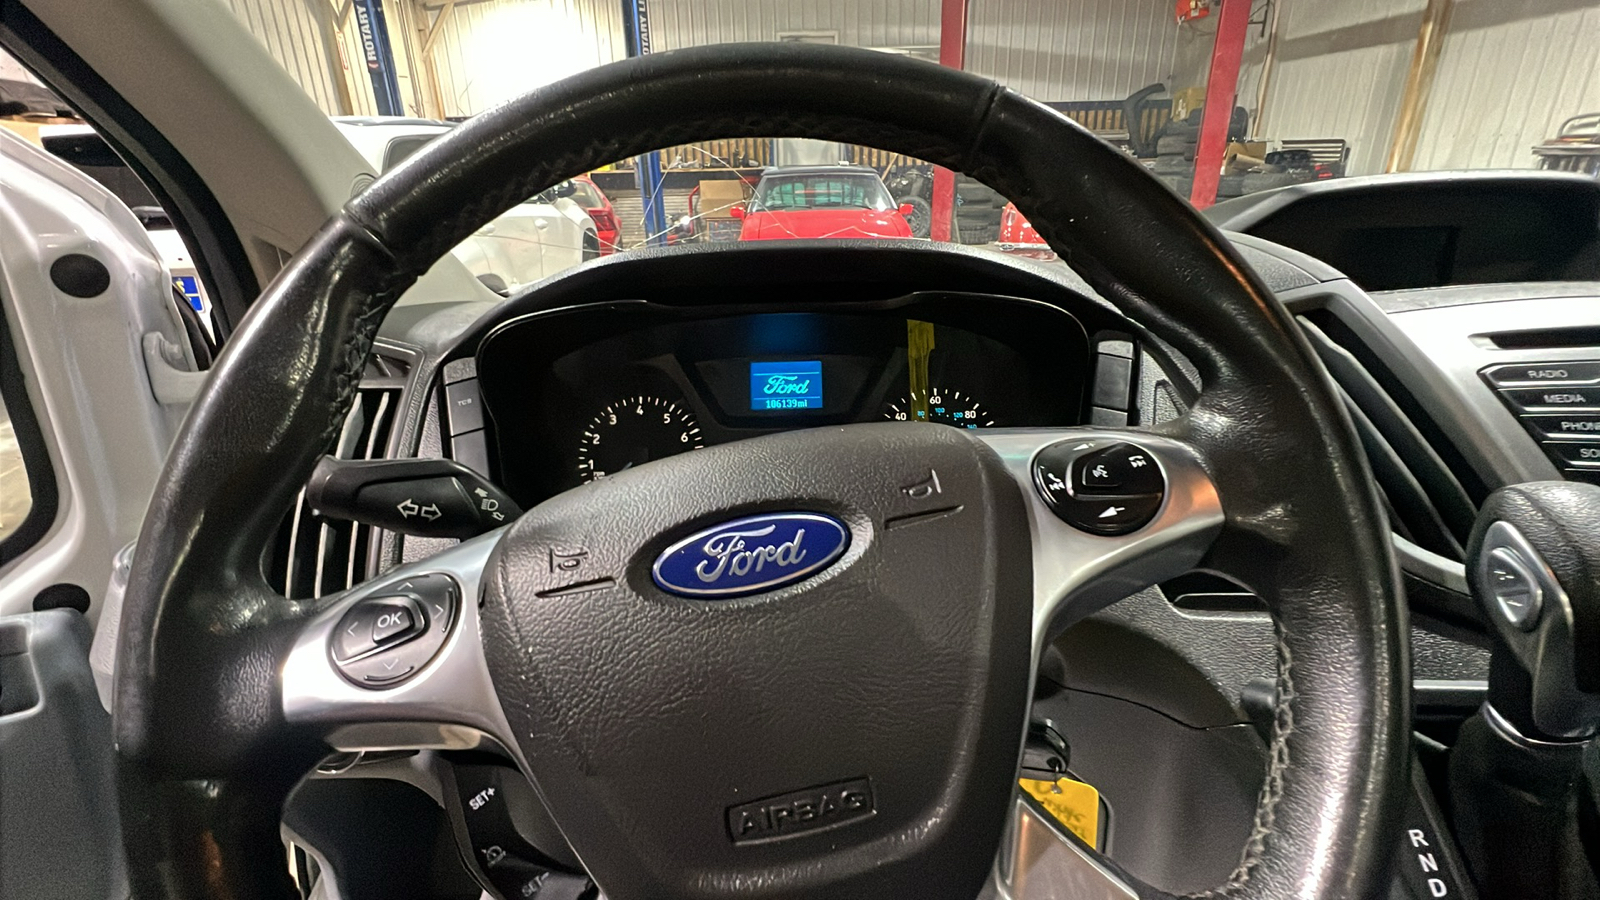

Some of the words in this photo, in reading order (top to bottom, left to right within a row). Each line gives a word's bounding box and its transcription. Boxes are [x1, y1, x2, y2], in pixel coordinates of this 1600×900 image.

[356, 4, 378, 61] ROTARY
[639, 14, 650, 56] OTARY
[1527, 369, 1569, 379] RADIO
[763, 375, 810, 394] Ford
[929, 396, 942, 404] 60
[1543, 394, 1587, 403] MEDIA
[636, 405, 644, 416] 4
[964, 410, 977, 419] 80
[609, 414, 617, 425] 3
[663, 413, 671, 424] 5
[894, 412, 907, 421] 40
[592, 434, 601, 445] 2
[680, 432, 689, 443] 6
[1580, 448, 1600, 458] SO
[588, 459, 594, 470] 1
[695, 523, 806, 583] Ford
[376, 611, 403, 628] OK
[468, 787, 496, 811] SET+
[738, 791, 865, 835] AIRBAG
[1407, 829, 1430, 848] R
[1417, 852, 1439, 873] N
[1427, 878, 1448, 898] D
